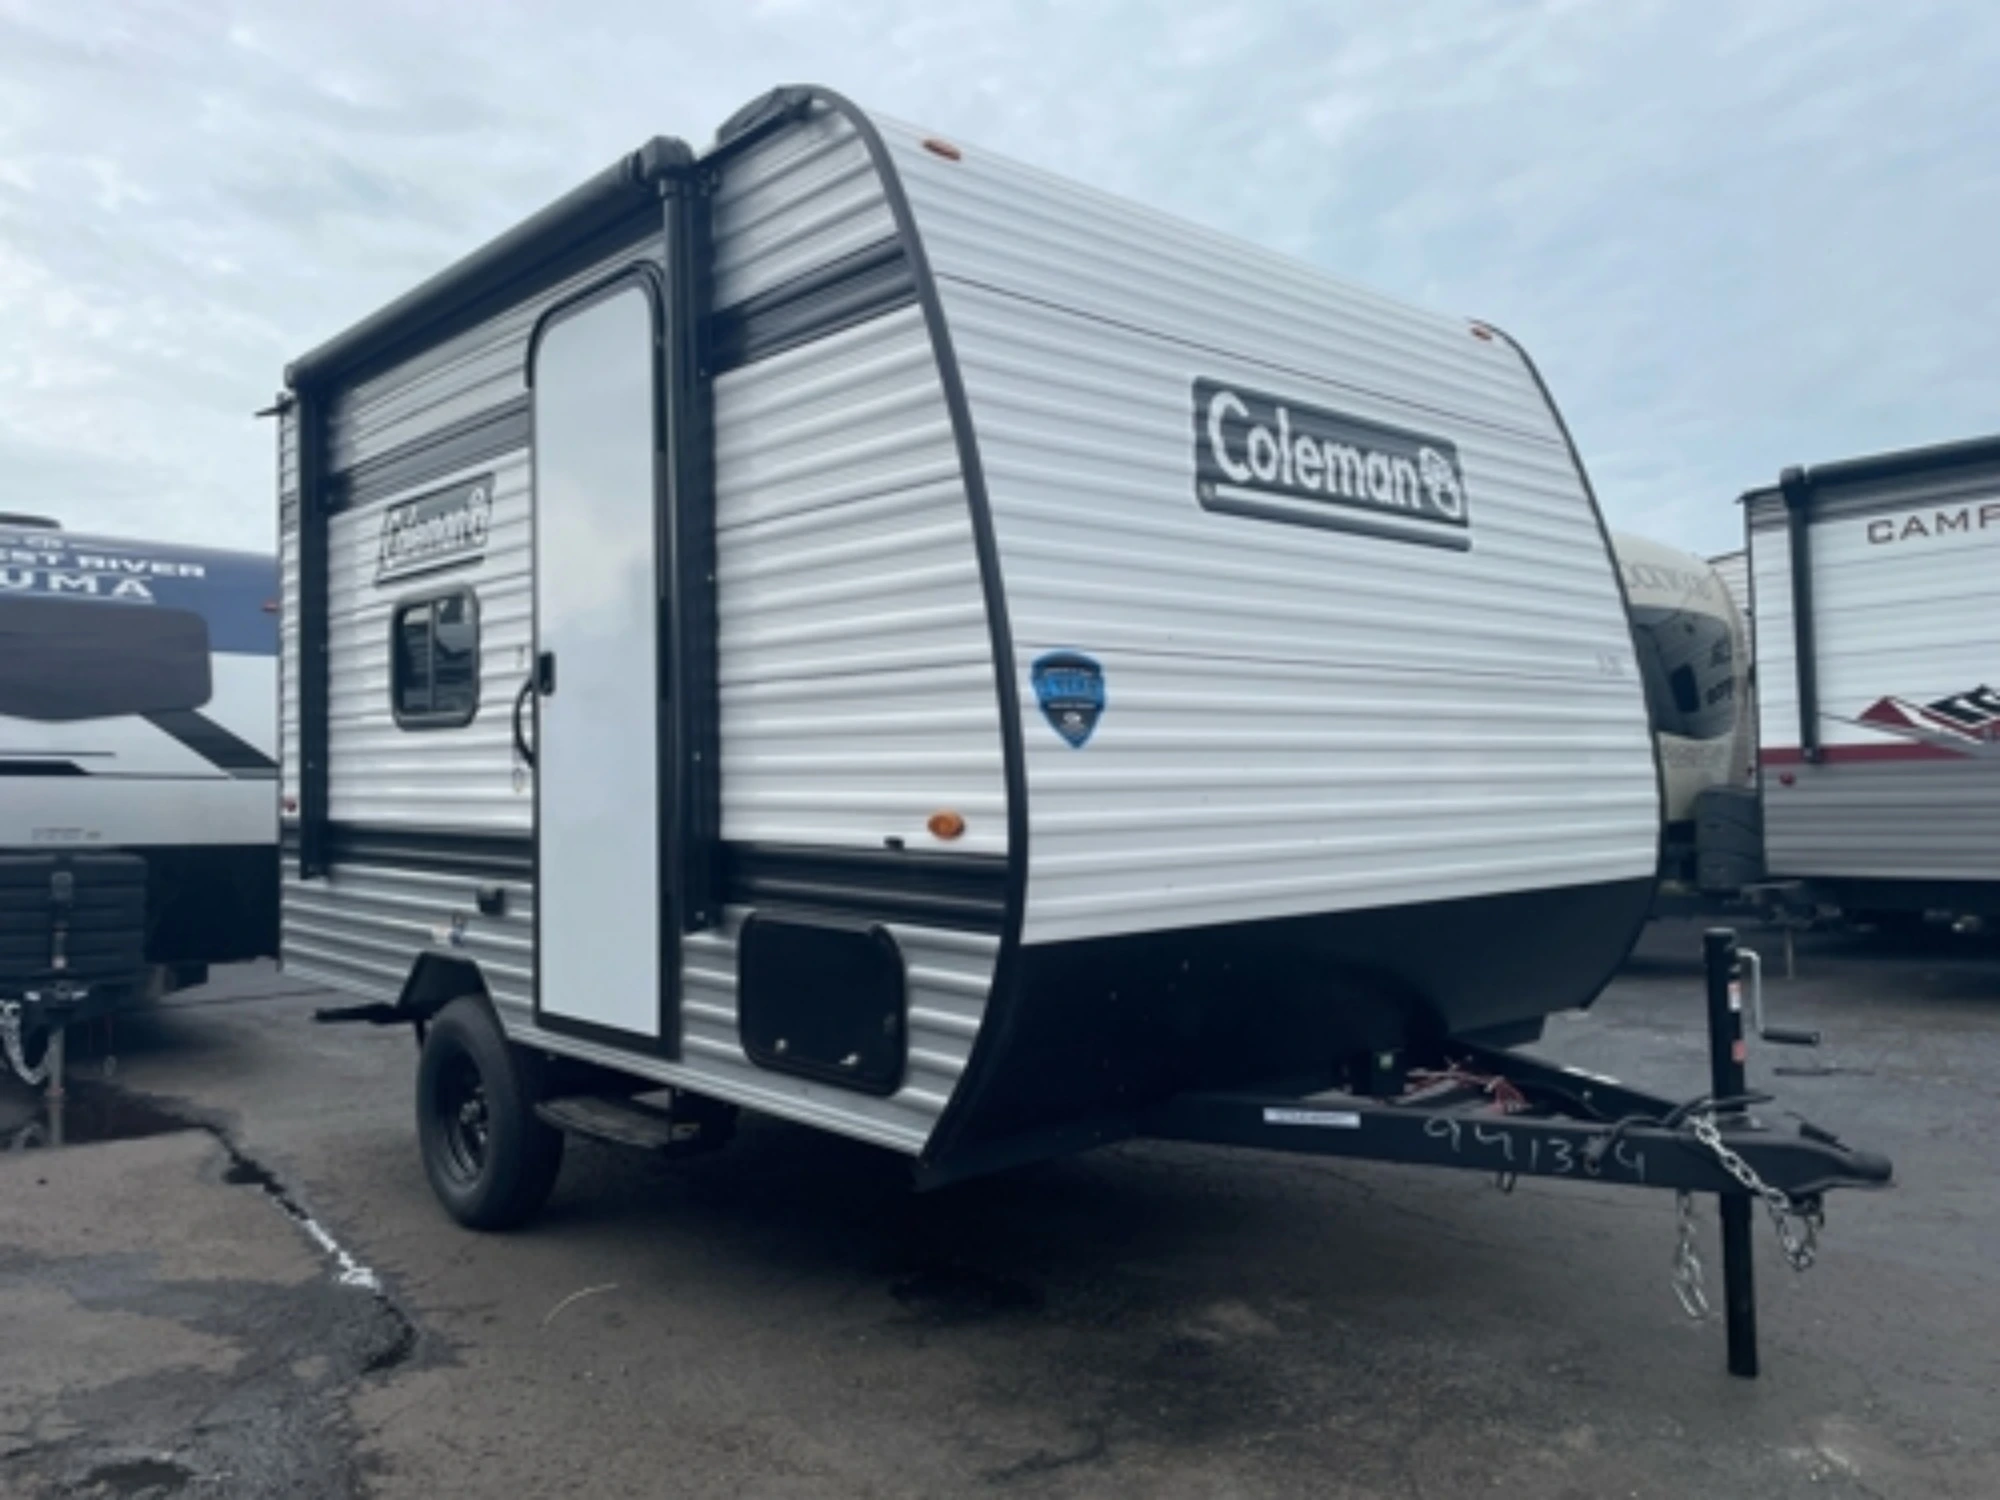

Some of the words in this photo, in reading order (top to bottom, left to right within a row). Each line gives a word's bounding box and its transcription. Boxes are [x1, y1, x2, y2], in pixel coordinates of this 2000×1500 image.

[1207, 391, 1421, 508] Coleman
[76, 554, 206, 579] RIVER
[0, 569, 153, 597] UMA
